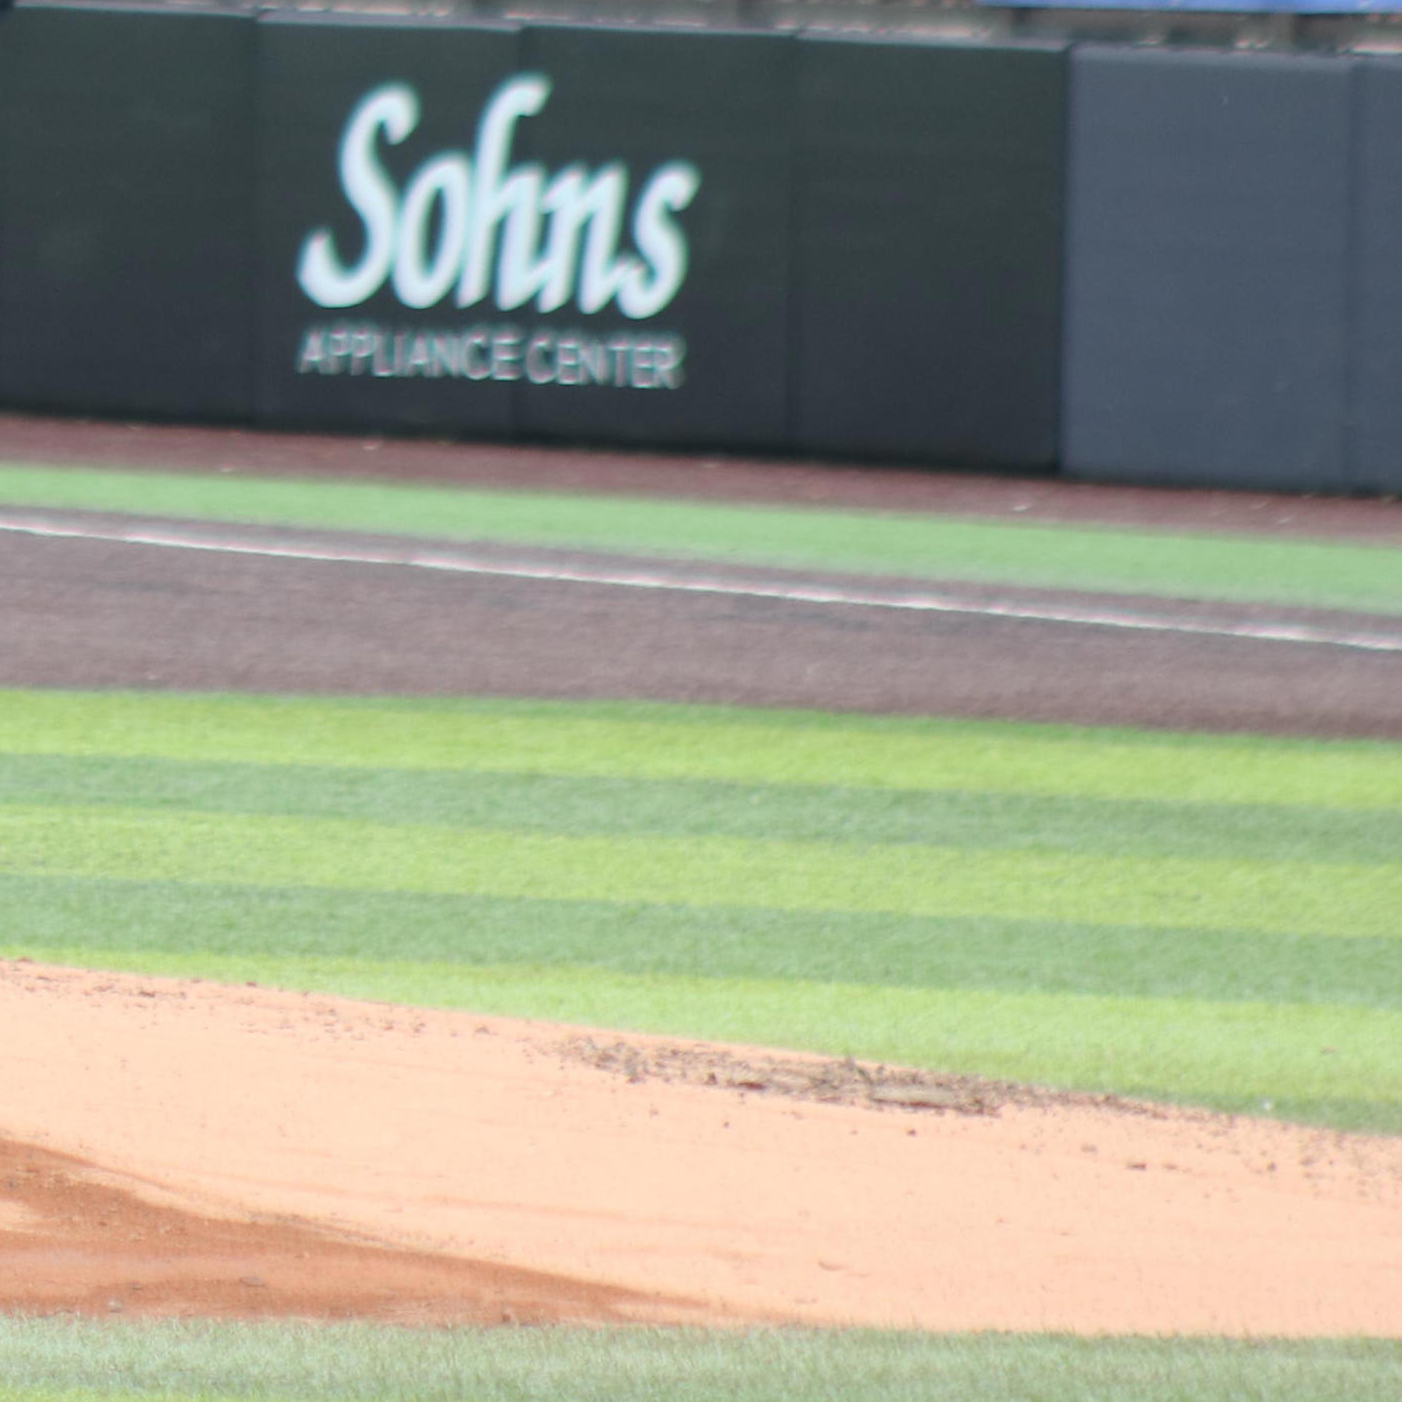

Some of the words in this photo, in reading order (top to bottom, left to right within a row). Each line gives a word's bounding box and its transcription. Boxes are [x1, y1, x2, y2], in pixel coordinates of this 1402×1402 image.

[296, 72, 702, 320] Sohns
[298, 320, 524, 382] APPLIANCE
[526, 331, 687, 390] CENTER
